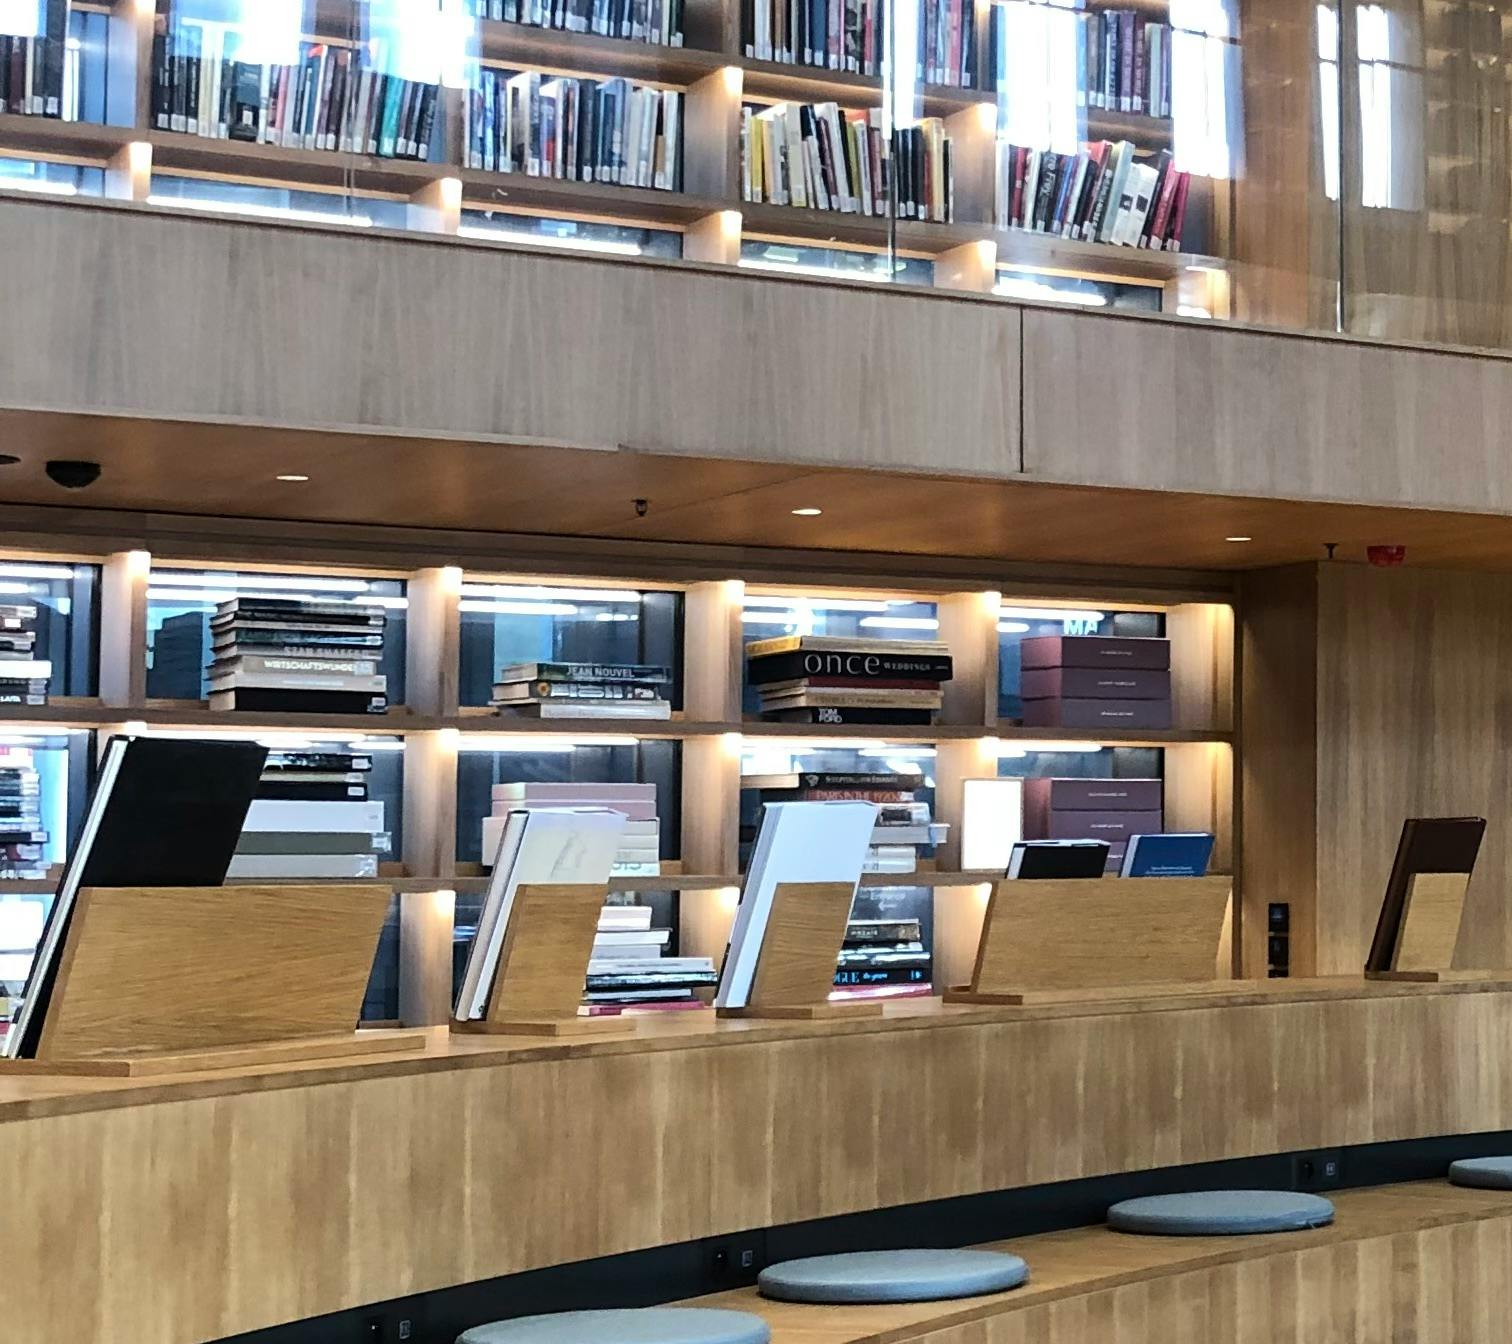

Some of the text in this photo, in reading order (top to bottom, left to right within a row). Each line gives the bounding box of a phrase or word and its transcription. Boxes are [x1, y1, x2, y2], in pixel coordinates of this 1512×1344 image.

[567, 666, 635, 678] JEAN NOUVEL
[805, 654, 880, 675] once
